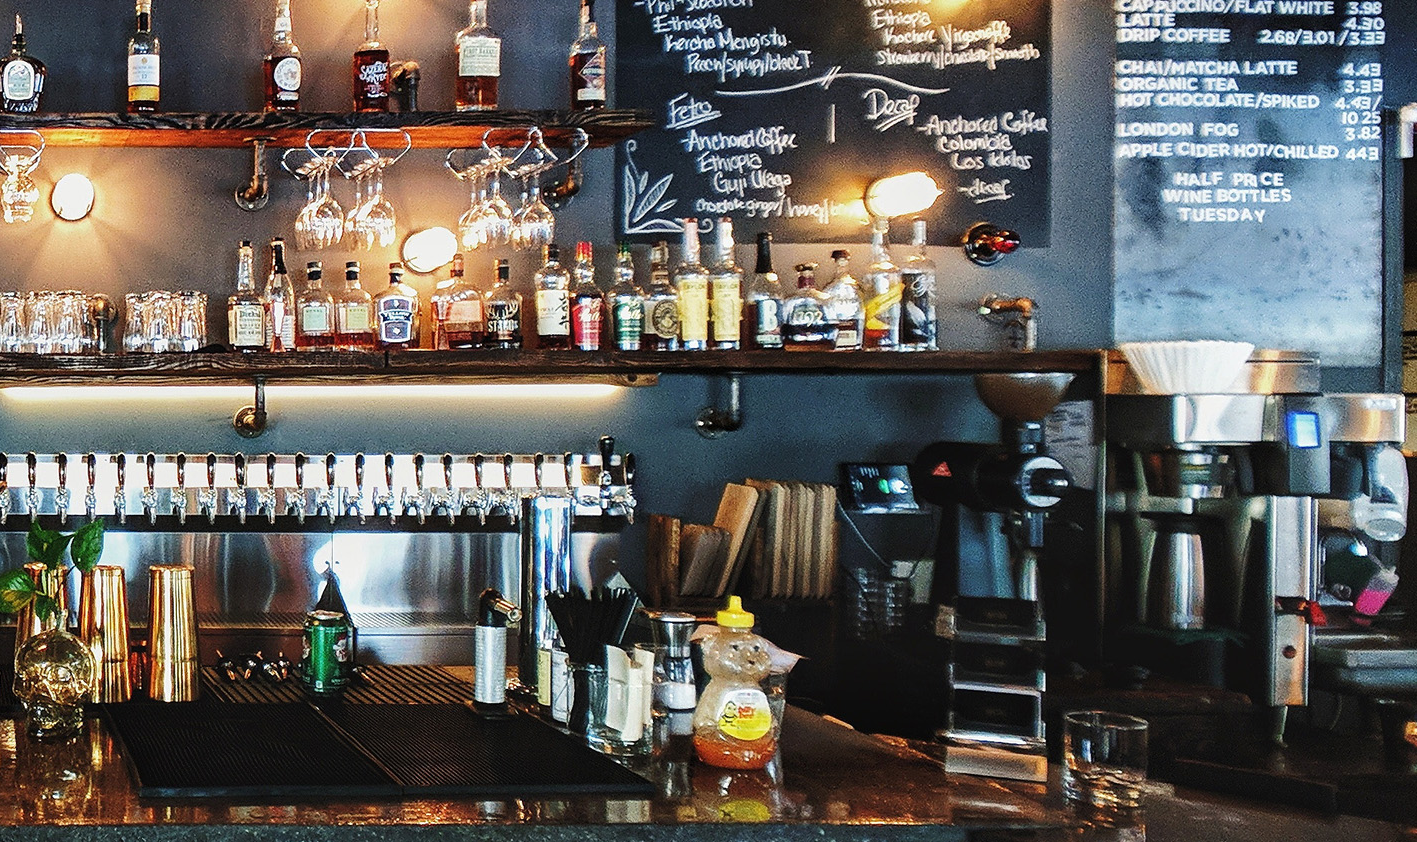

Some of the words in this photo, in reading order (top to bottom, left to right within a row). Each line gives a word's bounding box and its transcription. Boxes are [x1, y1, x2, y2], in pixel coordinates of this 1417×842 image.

[1279, 1, 1335, 14] WHITE
[1346, 2, 1382, 15] 3.98
[1117, 14, 1176, 27] LATTE
[1343, 17, 1385, 31] 4.30
[1117, 28, 1161, 43] DRIP
[1164, 29, 1231, 43] COFFEE
[1117, 60, 1241, 75] CHAI/MATCHA
[1245, 61, 1298, 75] LATTE
[1342, 63, 1382, 77] 4.43
[1117, 78, 1199, 91] ORGANIC
[1205, 78, 1239, 92] TEA
[1343, 79, 1383, 93] 3.33
[1116, 94, 1154, 107] HOT
[1157, 93, 1320, 109] CHOCOLATE/SPIKED
[1117, 123, 1194, 137] LONDON
[1201, 123, 1239, 137] FOG
[1118, 144, 1174, 158] APPLE
[1176, 142, 1231, 157] CIDER
[1234, 144, 1339, 159] HOT/CHILLED
[1174, 173, 1223, 186] HALF
[1162, 189, 1212, 203] WINE
[1216, 188, 1292, 202] BOTTLES
[1179, 208, 1266, 223] TUESDAY
